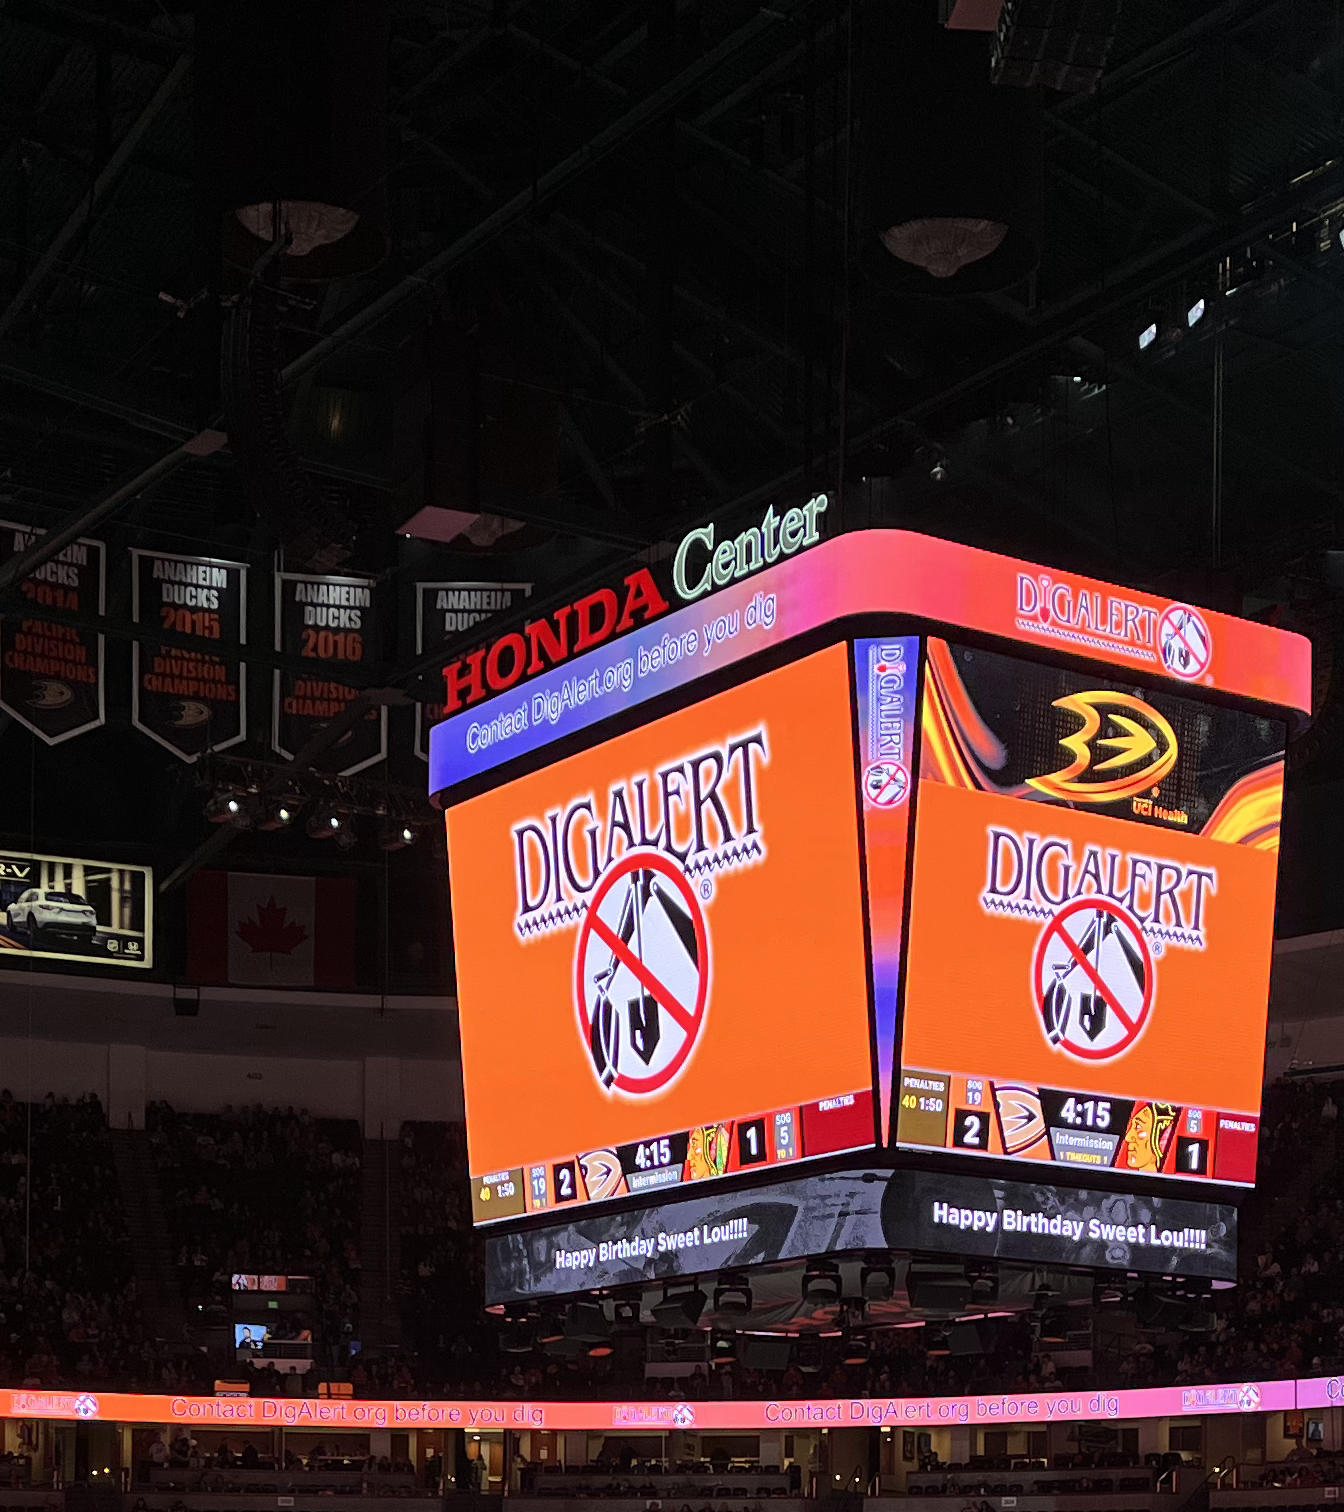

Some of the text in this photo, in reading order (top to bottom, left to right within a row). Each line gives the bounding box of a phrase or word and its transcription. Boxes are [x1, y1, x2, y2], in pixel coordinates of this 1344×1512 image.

[153, 559, 228, 589] ANAHEIM
[162, 584, 219, 609] DUCKS
[295, 582, 371, 608] ANAHEIM
[436, 590, 512, 609] ANAHEIM
[443, 494, 827, 714] HONDA Center
[160, 607, 221, 640] 2015
[304, 604, 361, 630] DUCKS
[301, 628, 364, 662] 2016
[466, 593, 777, 755] Contact DigAlert.org before you dig
[514, 731, 768, 917] DIGALERT
[1154, 806, 1189, 825] Health
[987, 829, 1216, 933] DIGALERT
[902, 1094, 944, 1113] 40 1:50
[967, 1090, 983, 1106] 19
[1060, 1097, 1112, 1130] 4:15
[1189, 1120, 1199, 1134] 5
[746, 1126, 758, 1157] 1
[780, 1125, 790, 1146] 5
[963, 1114, 981, 1146] 2
[1055, 1131, 1114, 1153] Intermission
[634, 1139, 672, 1169] 4:15
[1187, 1142, 1201, 1171] 1
[532, 1177, 546, 1197] 19
[558, 1172, 572, 1197] 2
[933, 1201, 1207, 1250] Happy Birthday Sweet Lou!!!!
[556, 1217, 748, 1272] Happy Birthday Sweet Lou!!!!
